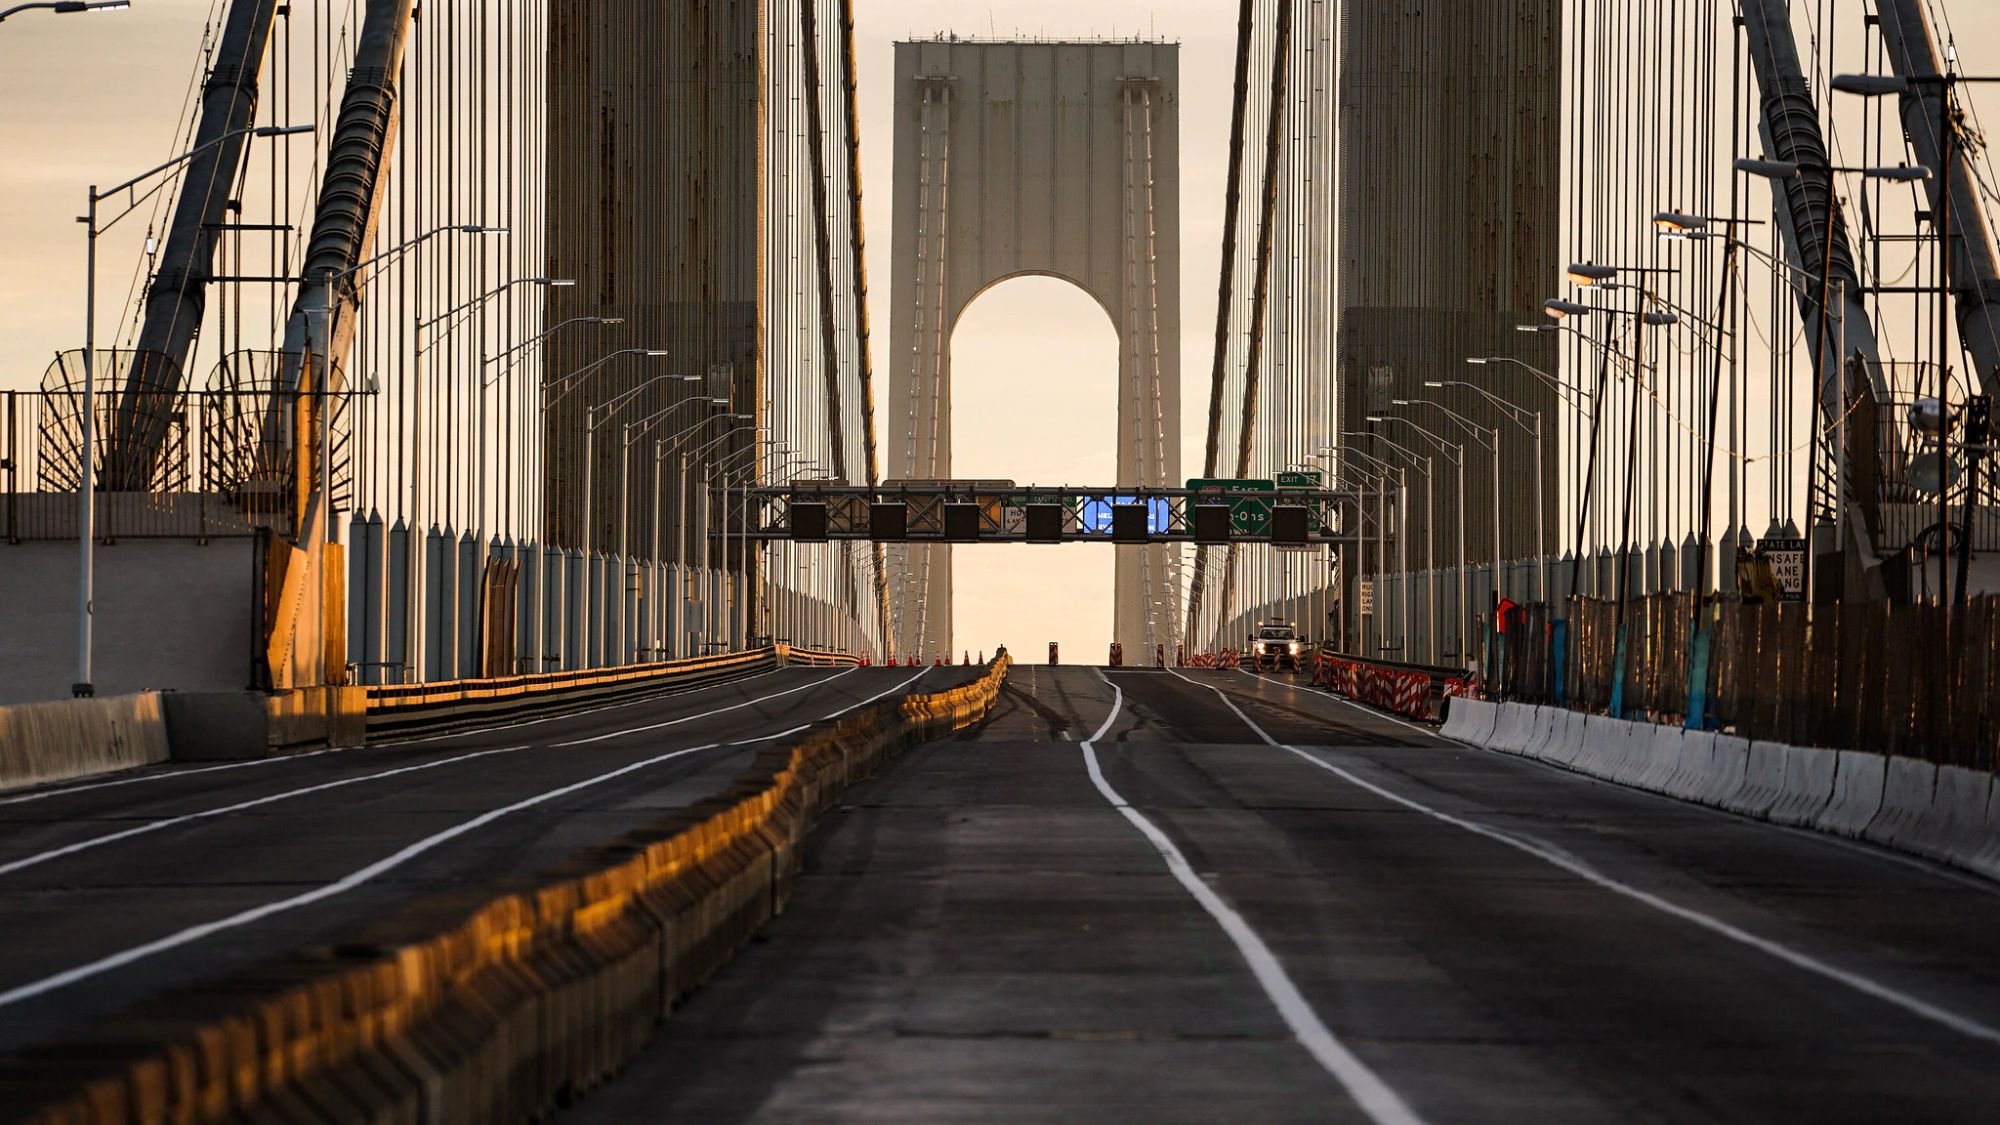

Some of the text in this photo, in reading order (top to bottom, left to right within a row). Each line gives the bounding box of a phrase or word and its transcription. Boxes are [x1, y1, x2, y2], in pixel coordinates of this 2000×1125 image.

[1280, 475, 1298, 483] EXIT
[1758, 541, 1785, 550] STATE
[1768, 553, 1805, 564] NSAFE
[1775, 566, 1799, 576] ANE
[1776, 577, 1800, 588] ANG
